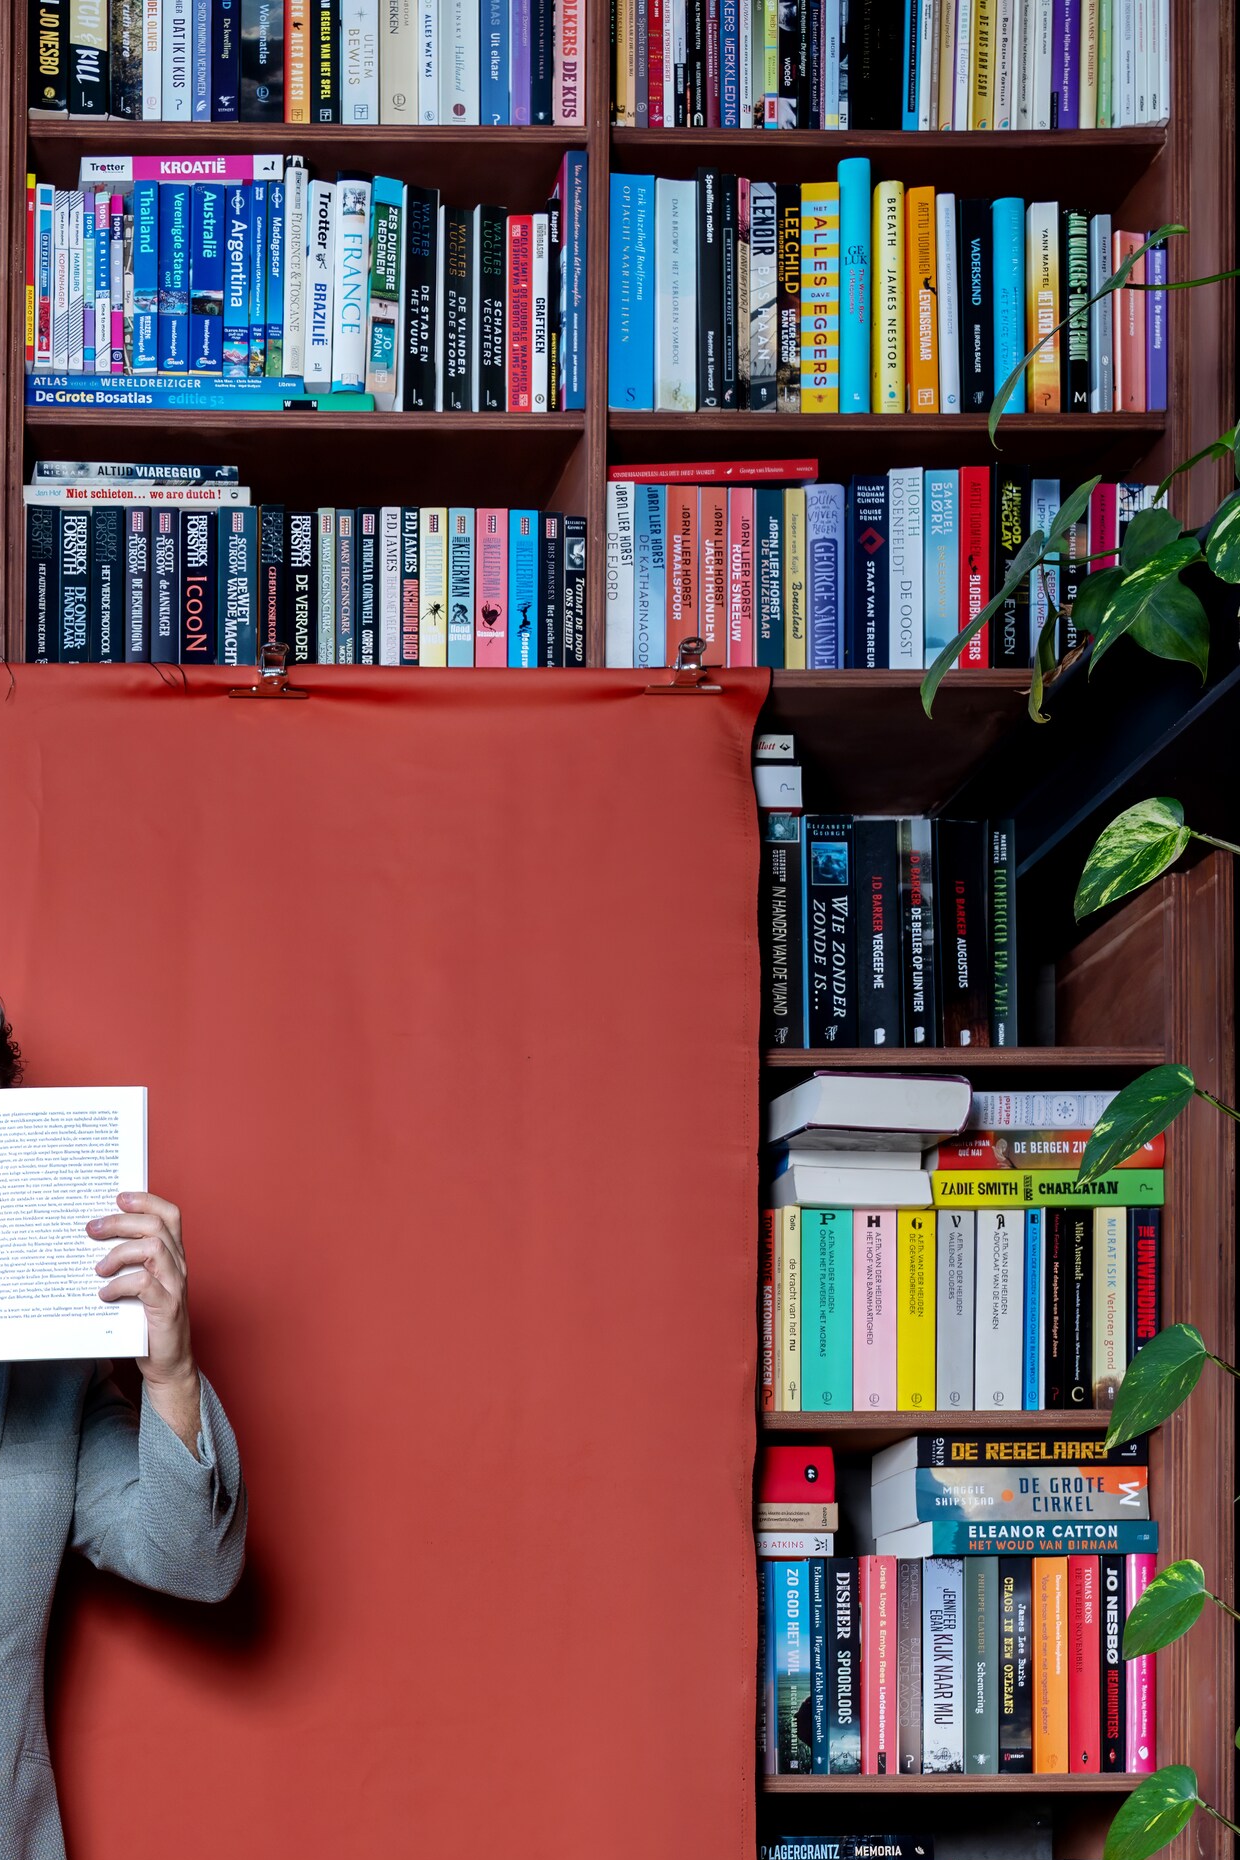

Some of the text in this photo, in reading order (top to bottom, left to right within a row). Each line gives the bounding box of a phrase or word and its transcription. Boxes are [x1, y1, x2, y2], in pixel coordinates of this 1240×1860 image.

[40, 8, 59, 28] JO
[75, 49, 101, 84] KILL
[562, 61, 577, 118] DE KUS
[724, 38, 736, 125] WERKKLEDING
[977, 15, 988, 97] DE KUS VAN ESAU
[160, 160, 227, 174] KROATIË
[140, 188, 153, 253] Thailand
[202, 191, 217, 258] Australië
[784, 207, 799, 294] LEE CHILD
[814, 217, 827, 287] ALLES
[229, 219, 247, 307] Argentina
[312, 192, 331, 346] Trotter BRAZILIË
[341, 233, 363, 334] FRANCE
[887, 197, 897, 369] BREATH JAMES NESTOR
[813, 304, 827, 386] EGGERS
[918, 289, 932, 361] LEVENSGEVAAR
[33, 377, 201, 388] ATLAS WERELDREIZIGER
[832, 940, 846, 1018] ZONDER
[940, 1182, 1018, 1196] ZADIE SMITH
[1137, 1239, 1156, 1338] UNWINDING
[951, 1441, 1109, 1459] DE REGELAARS
[1019, 1476, 1105, 1494] DE GROTE
[1032, 1495, 1094, 1513] CIRKEL
[969, 1524, 1118, 1539] ELEANOR CATTON
[836, 1572, 851, 1639] DISHER
[1106, 1568, 1118, 1591] JO
[837, 1650, 852, 1724] SPOORLOOS
[933, 1633, 954, 1725] KIJK NAAR MIJ
[1107, 1669, 1119, 1739] HEADHUNTERS
[768, 1843, 902, 1860] LAGERCRANTZ MEMORIA
